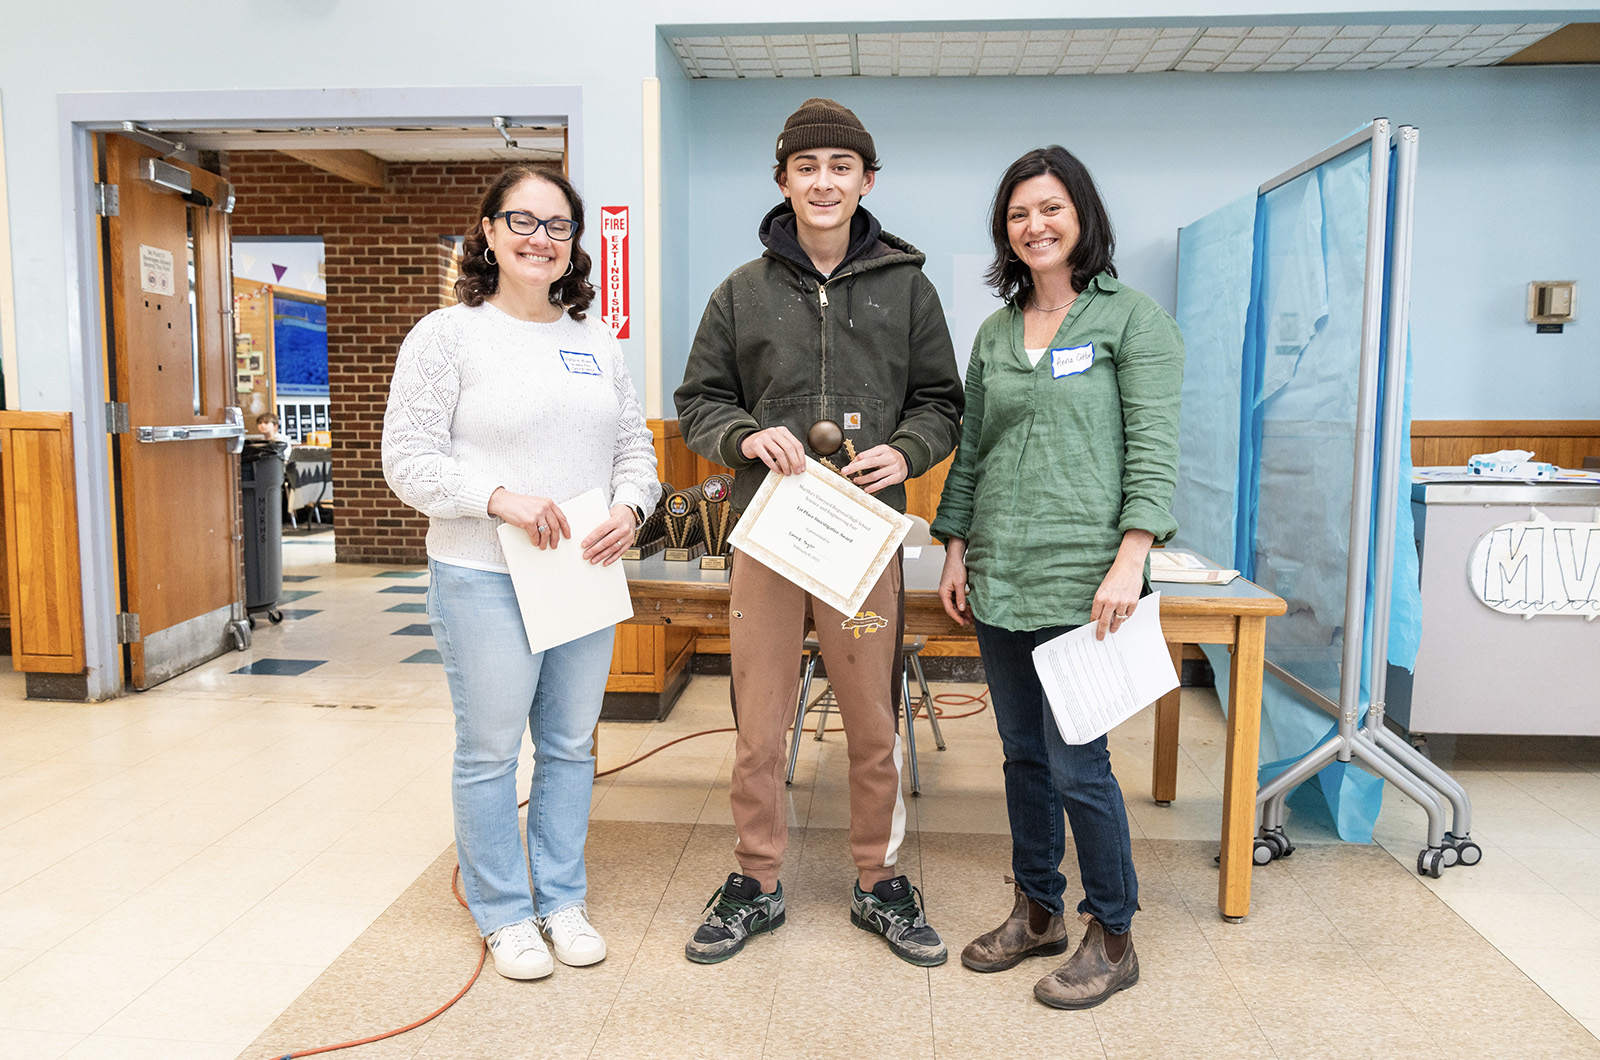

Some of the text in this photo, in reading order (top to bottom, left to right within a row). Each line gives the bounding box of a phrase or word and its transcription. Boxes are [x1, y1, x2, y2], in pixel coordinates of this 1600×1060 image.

[604, 218, 625, 230] FIRE
[611, 235, 620, 329] EXTINGUISHER
[803, 510, 815, 520] Place
[814, 517, 840, 535] Investigative
[839, 532, 853, 543] Award
[805, 496, 819, 507] Science
[827, 510, 850, 526] Engineering
[815, 495, 833, 508] Vineyard
[832, 505, 849, 518] Regional
[848, 515, 859, 524] High
[858, 521, 871, 531] School
